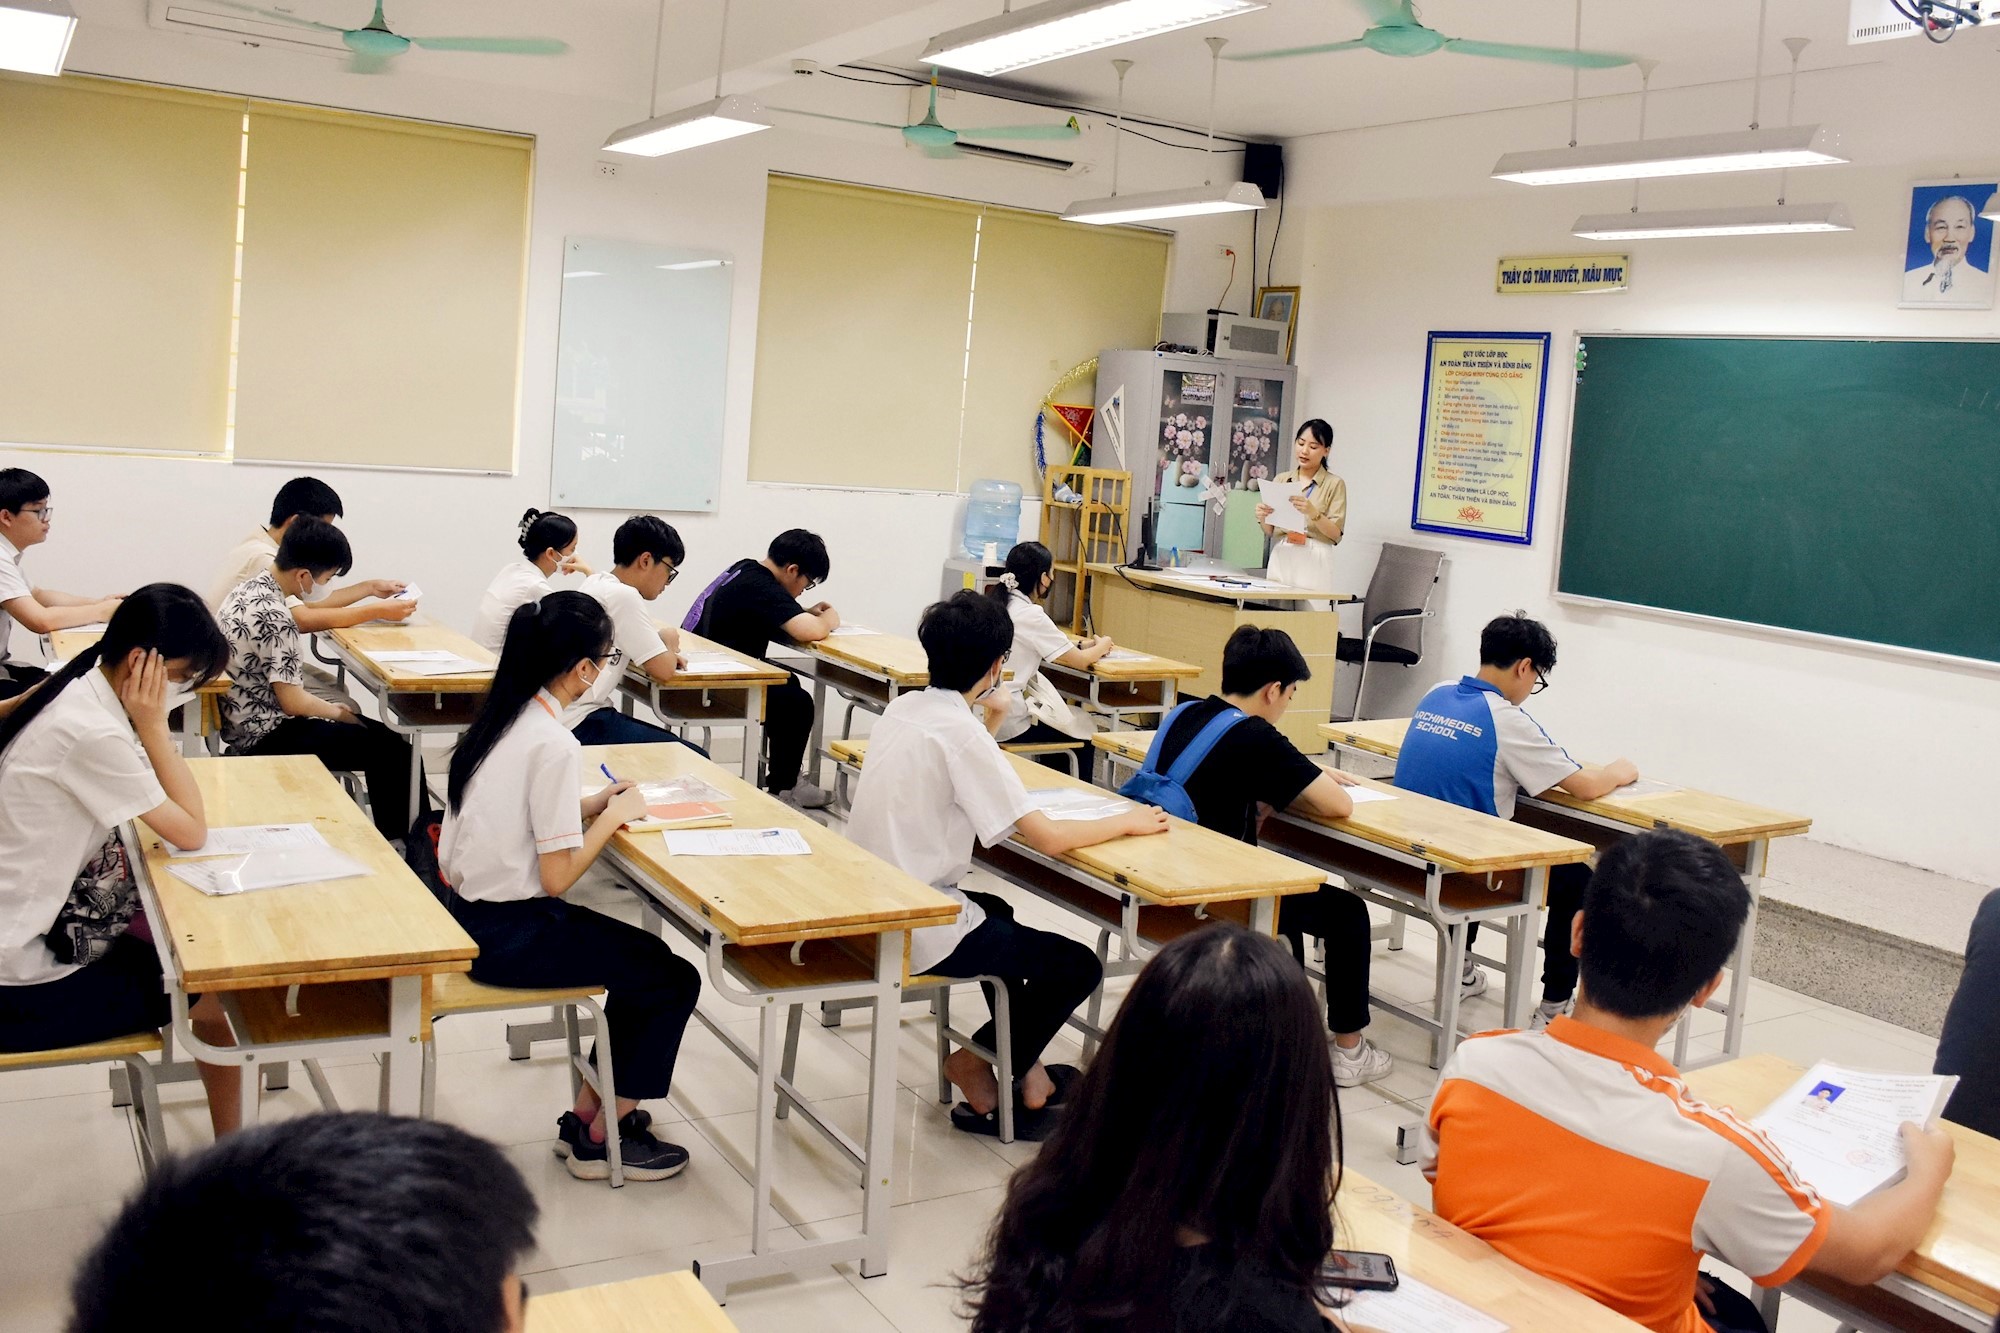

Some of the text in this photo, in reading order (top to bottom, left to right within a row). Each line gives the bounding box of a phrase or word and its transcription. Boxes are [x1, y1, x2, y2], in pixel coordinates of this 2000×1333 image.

[1502, 265, 1521, 284] THẦY
[1522, 267, 1532, 283] CÔ
[1534, 267, 1552, 283] TÂM
[1553, 264, 1580, 285] HUYẾT,
[1415, 721, 1458, 741] SCHOOL
